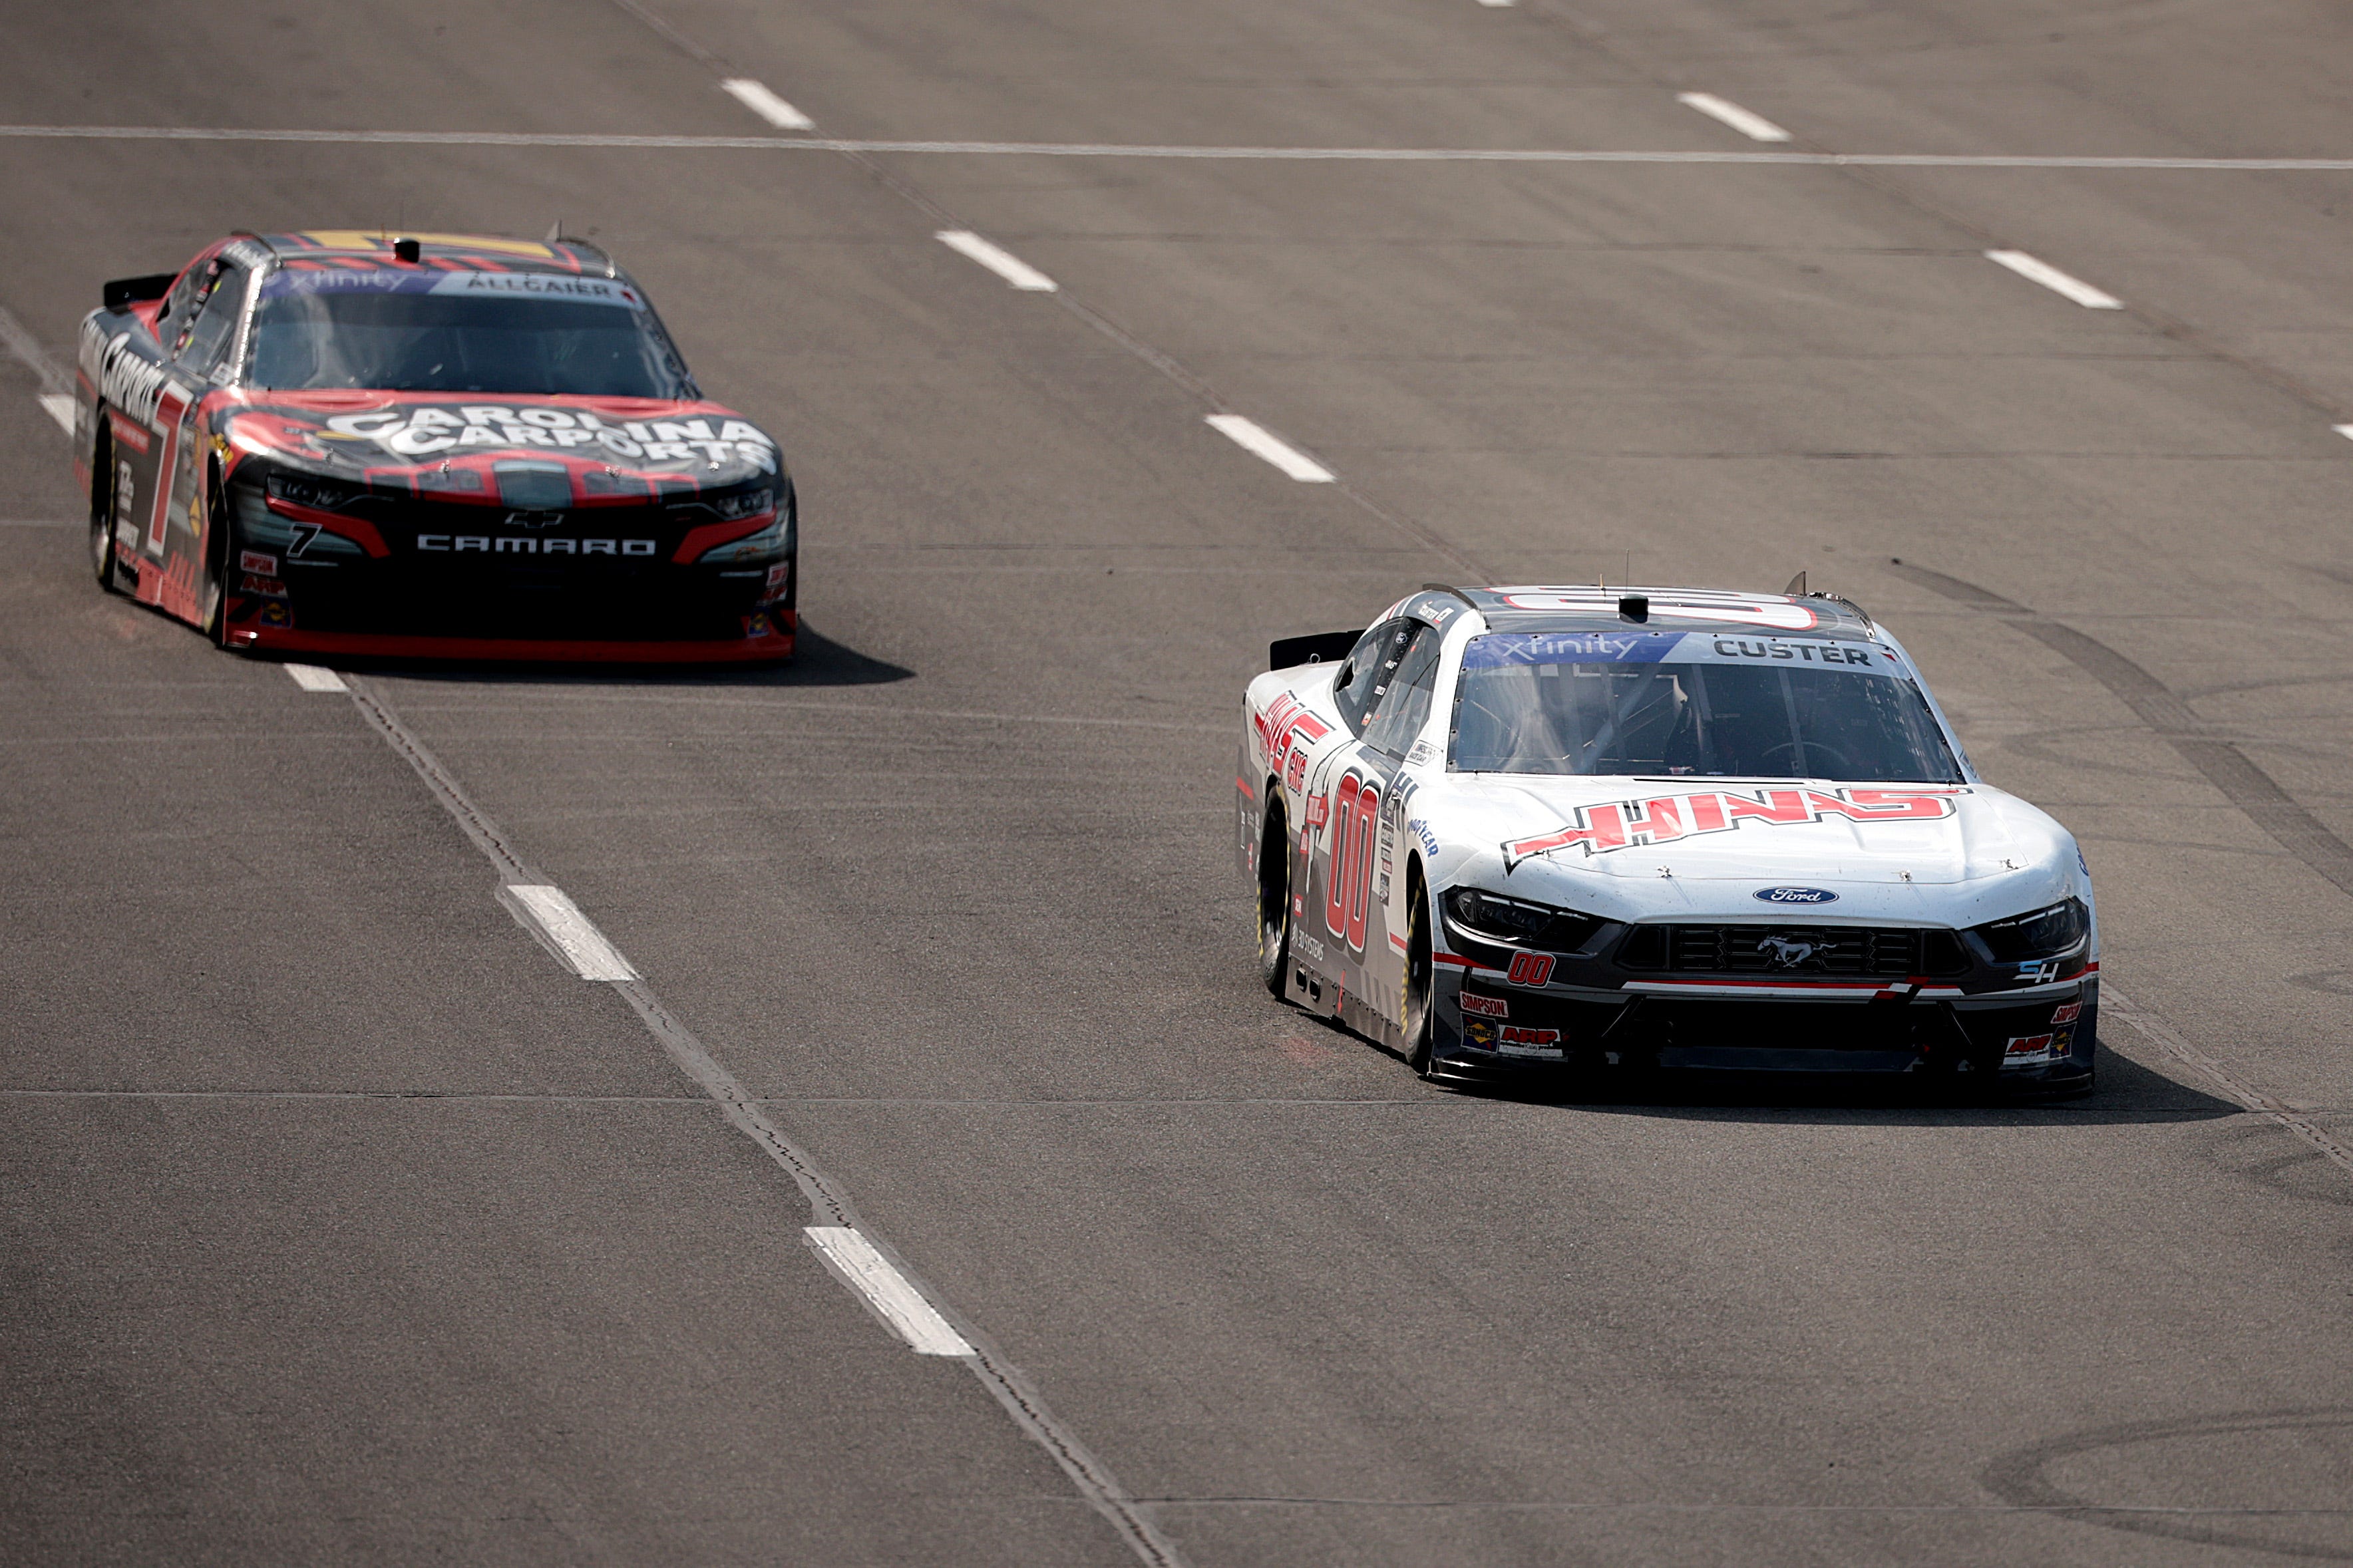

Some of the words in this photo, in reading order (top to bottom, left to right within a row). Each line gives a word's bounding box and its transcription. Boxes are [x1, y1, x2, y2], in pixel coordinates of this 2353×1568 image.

[289, 271, 411, 291] xfinity
[468, 275, 612, 297] ALLGAIER
[391, 423, 777, 476] CARPORTS
[287, 522, 323, 558] 7
[417, 534, 656, 555] CAMARO
[1503, 638, 1638, 661] xfinity
[1715, 639, 1873, 667] CUSTER
[1325, 770, 1381, 954] 00
[1769, 886, 1823, 903] Ford
[1507, 950, 1556, 989] 00
[1461, 993, 1506, 1017] SIMPSON
[1466, 1026, 1496, 1040] SUNOCO
[1501, 1026, 1558, 1044] ARP
[2007, 1034, 2052, 1052] ARP
